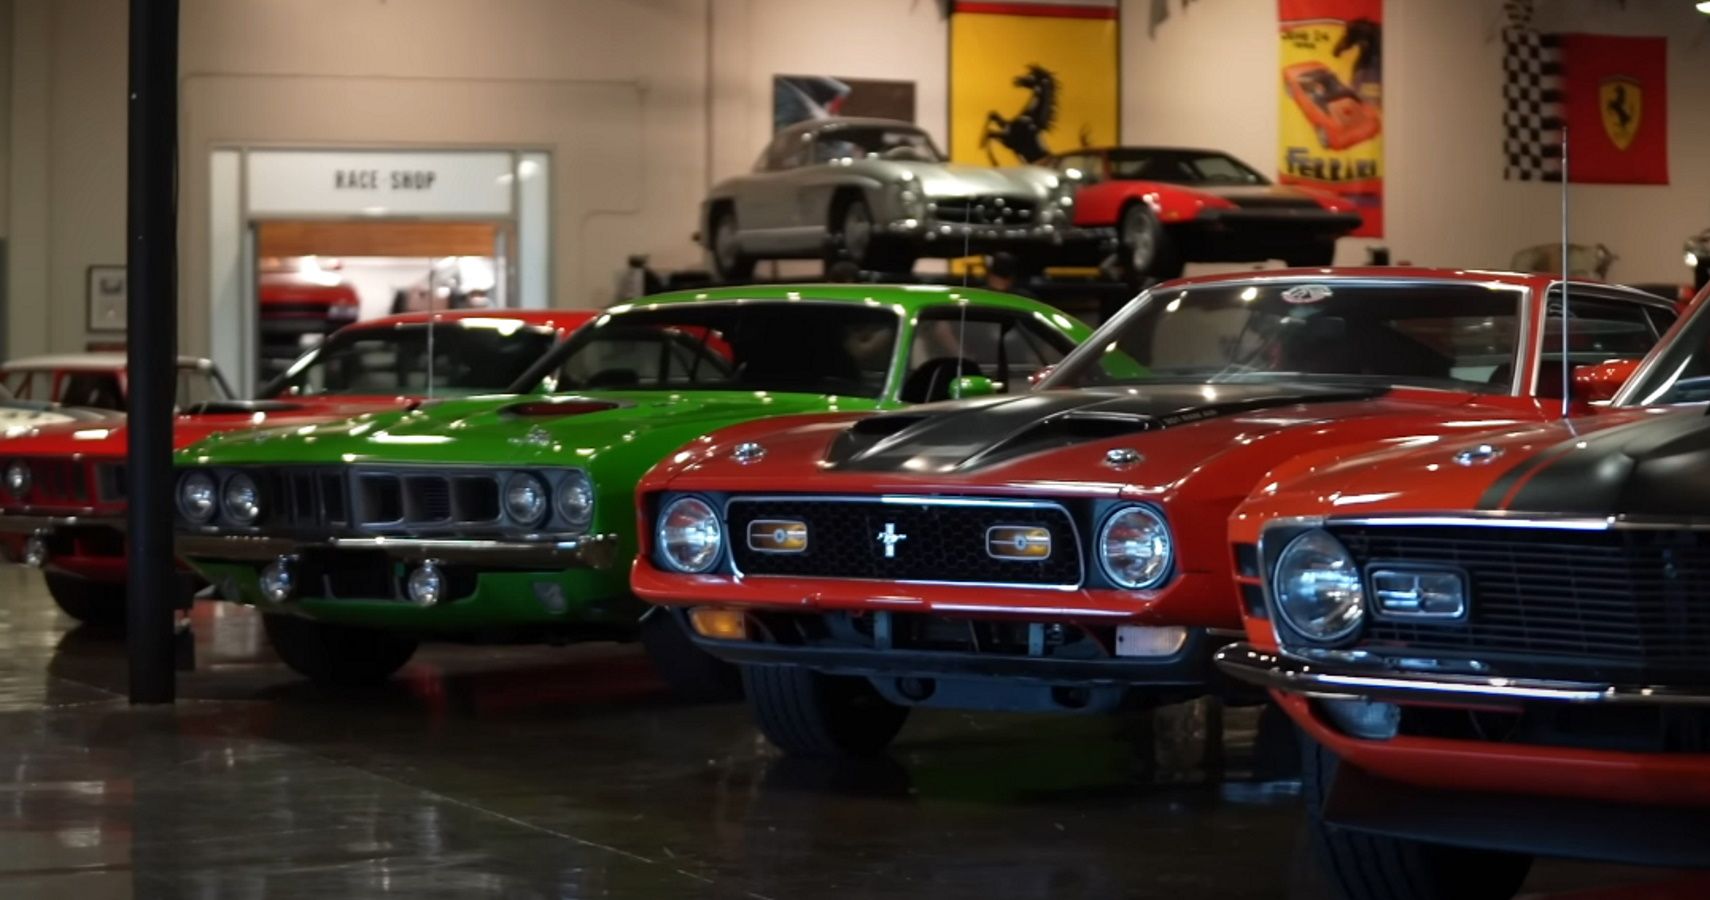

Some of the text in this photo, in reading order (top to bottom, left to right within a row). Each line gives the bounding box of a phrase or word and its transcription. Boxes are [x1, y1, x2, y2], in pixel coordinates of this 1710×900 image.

[1286, 147, 1377, 181] FERRARI
[334, 169, 436, 190] RACE SHOP
